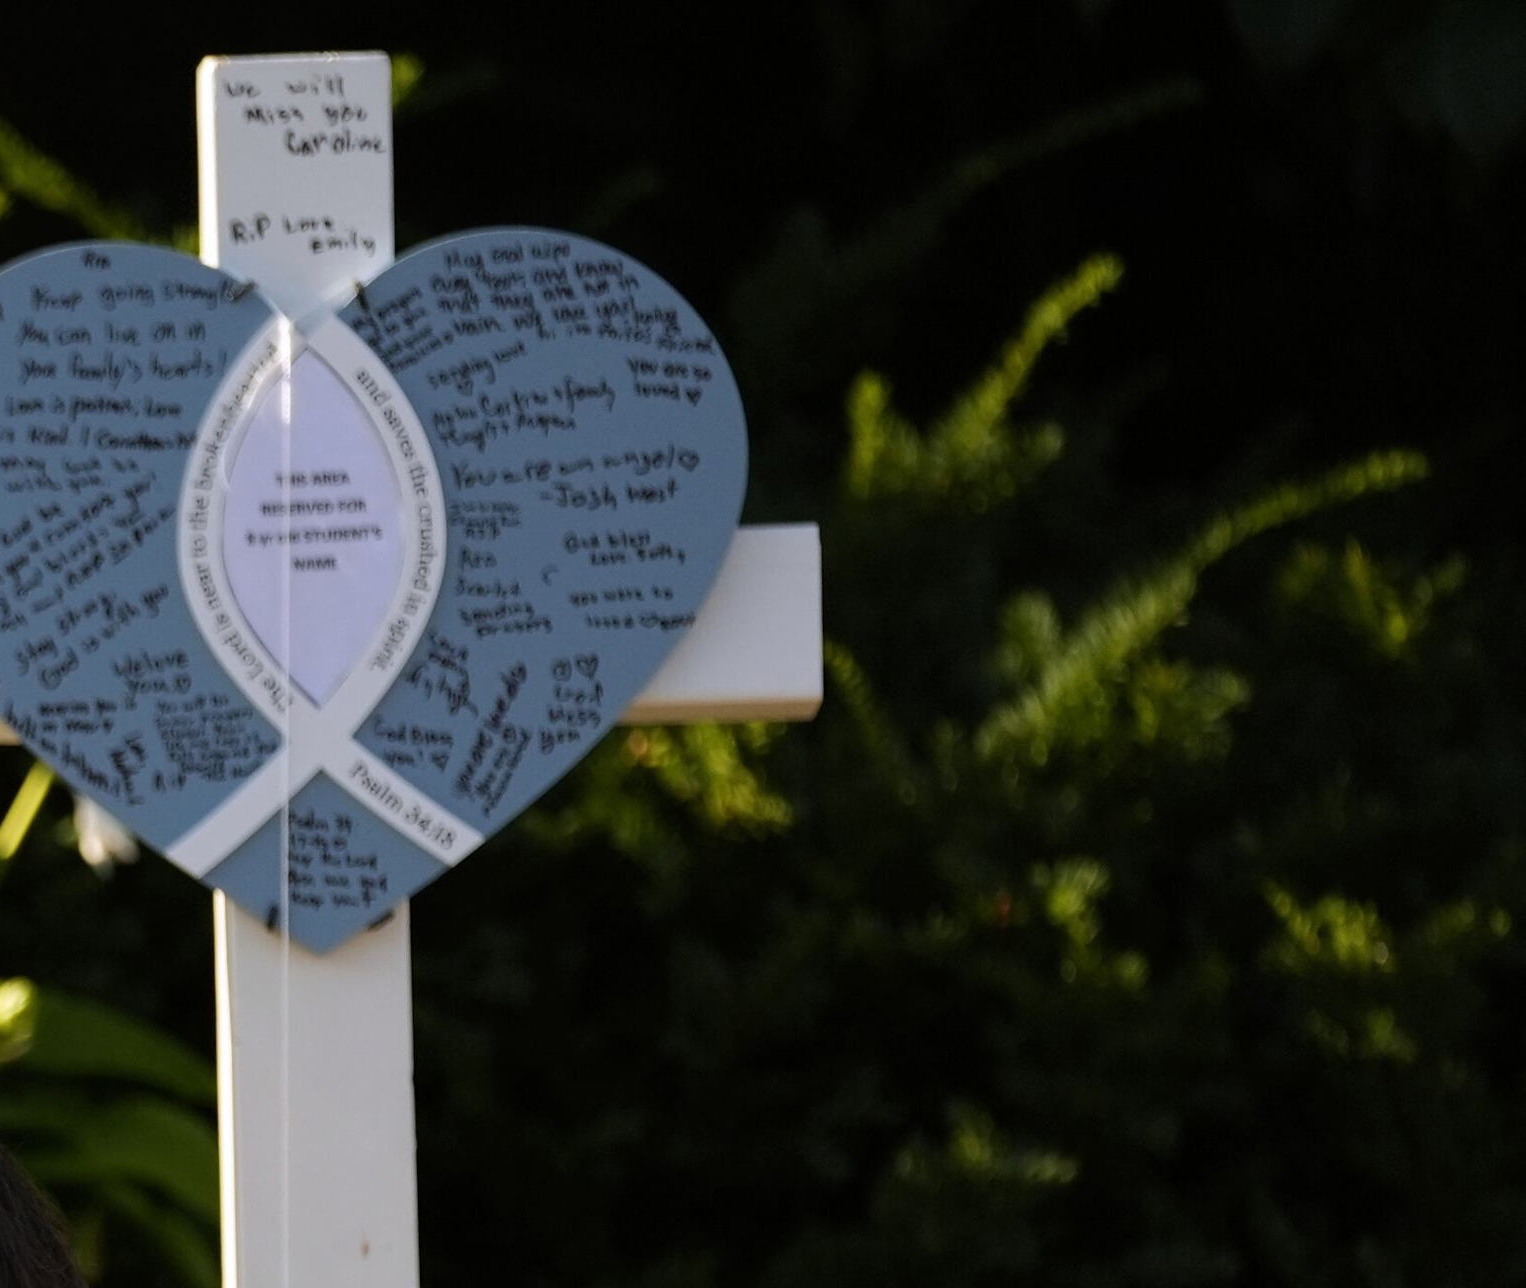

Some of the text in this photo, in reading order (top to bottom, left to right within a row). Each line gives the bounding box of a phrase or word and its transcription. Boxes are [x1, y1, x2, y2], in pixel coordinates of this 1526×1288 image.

[223, 73, 345, 98] We will
[321, 103, 368, 127] you
[532, 268, 568, 286] and
[98, 284, 155, 309] going
[16, 319, 205, 346] You can live on in
[355, 368, 393, 404] and
[383, 406, 414, 460] saves
[557, 457, 595, 476] an
[601, 443, 675, 477] angel
[310, 471, 351, 486] AREA
[407, 464, 429, 499] the
[188, 496, 209, 533] the
[337, 497, 367, 512] FOR
[302, 525, 382, 543] STUDENT'S
[191, 537, 208, 560] to
[411, 503, 436, 595] crushed
[195, 564, 222, 611] near
[403, 591, 420, 611] in
[213, 611, 231, 628] is
[222, 631, 265, 685] Lord
[347, 760, 404, 814] Psalm
